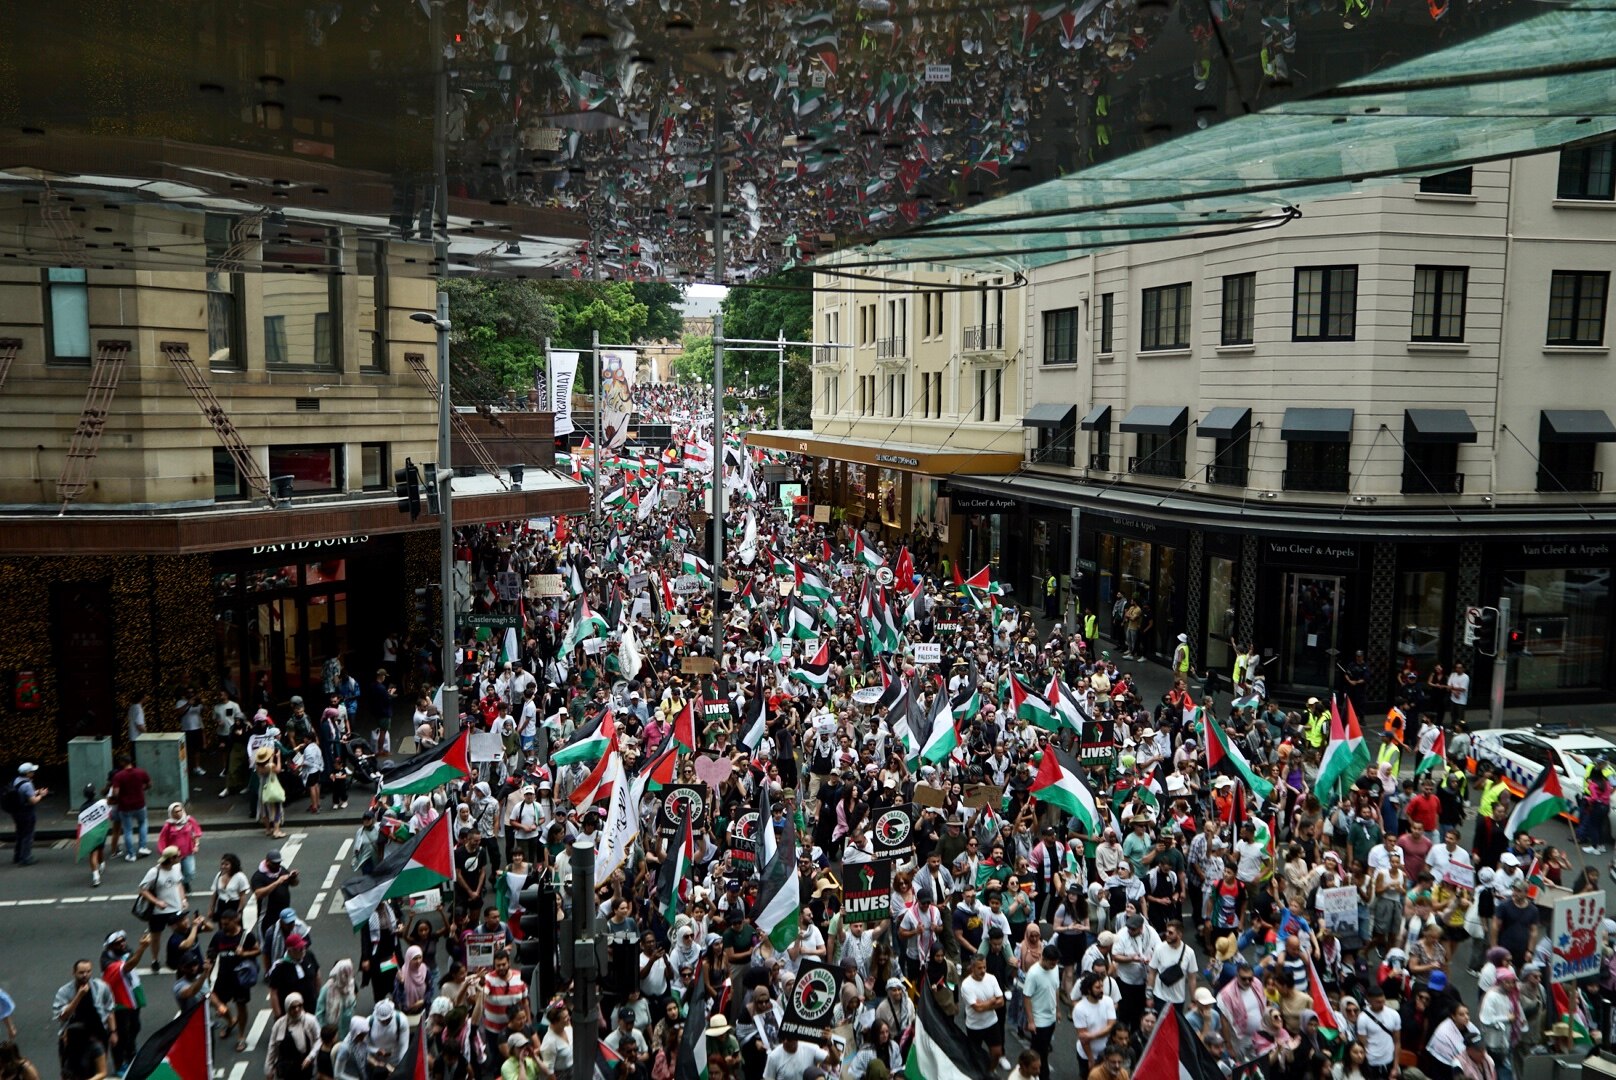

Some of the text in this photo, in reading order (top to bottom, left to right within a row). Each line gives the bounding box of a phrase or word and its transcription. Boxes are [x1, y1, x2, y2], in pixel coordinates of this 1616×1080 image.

[556, 371, 572, 421] KANDINSKY
[971, 499, 988, 507] Cleef
[996, 499, 1016, 508] Arpels
[1270, 543, 1355, 558] Van Cleef & Arpels
[1522, 544, 1540, 554] Van
[1542, 544, 1569, 554] Cleef
[1580, 544, 1609, 556] Arpels
[467, 615, 517, 624] Castlereagh St
[704, 703, 730, 714] LIVES
[1081, 745, 1112, 759] LIVES
[845, 894, 889, 912] LIVES
[799, 970, 835, 996] FREE PALESTINE
[800, 997, 832, 1018] APARTHEID
[782, 1022, 798, 1033] STOP
